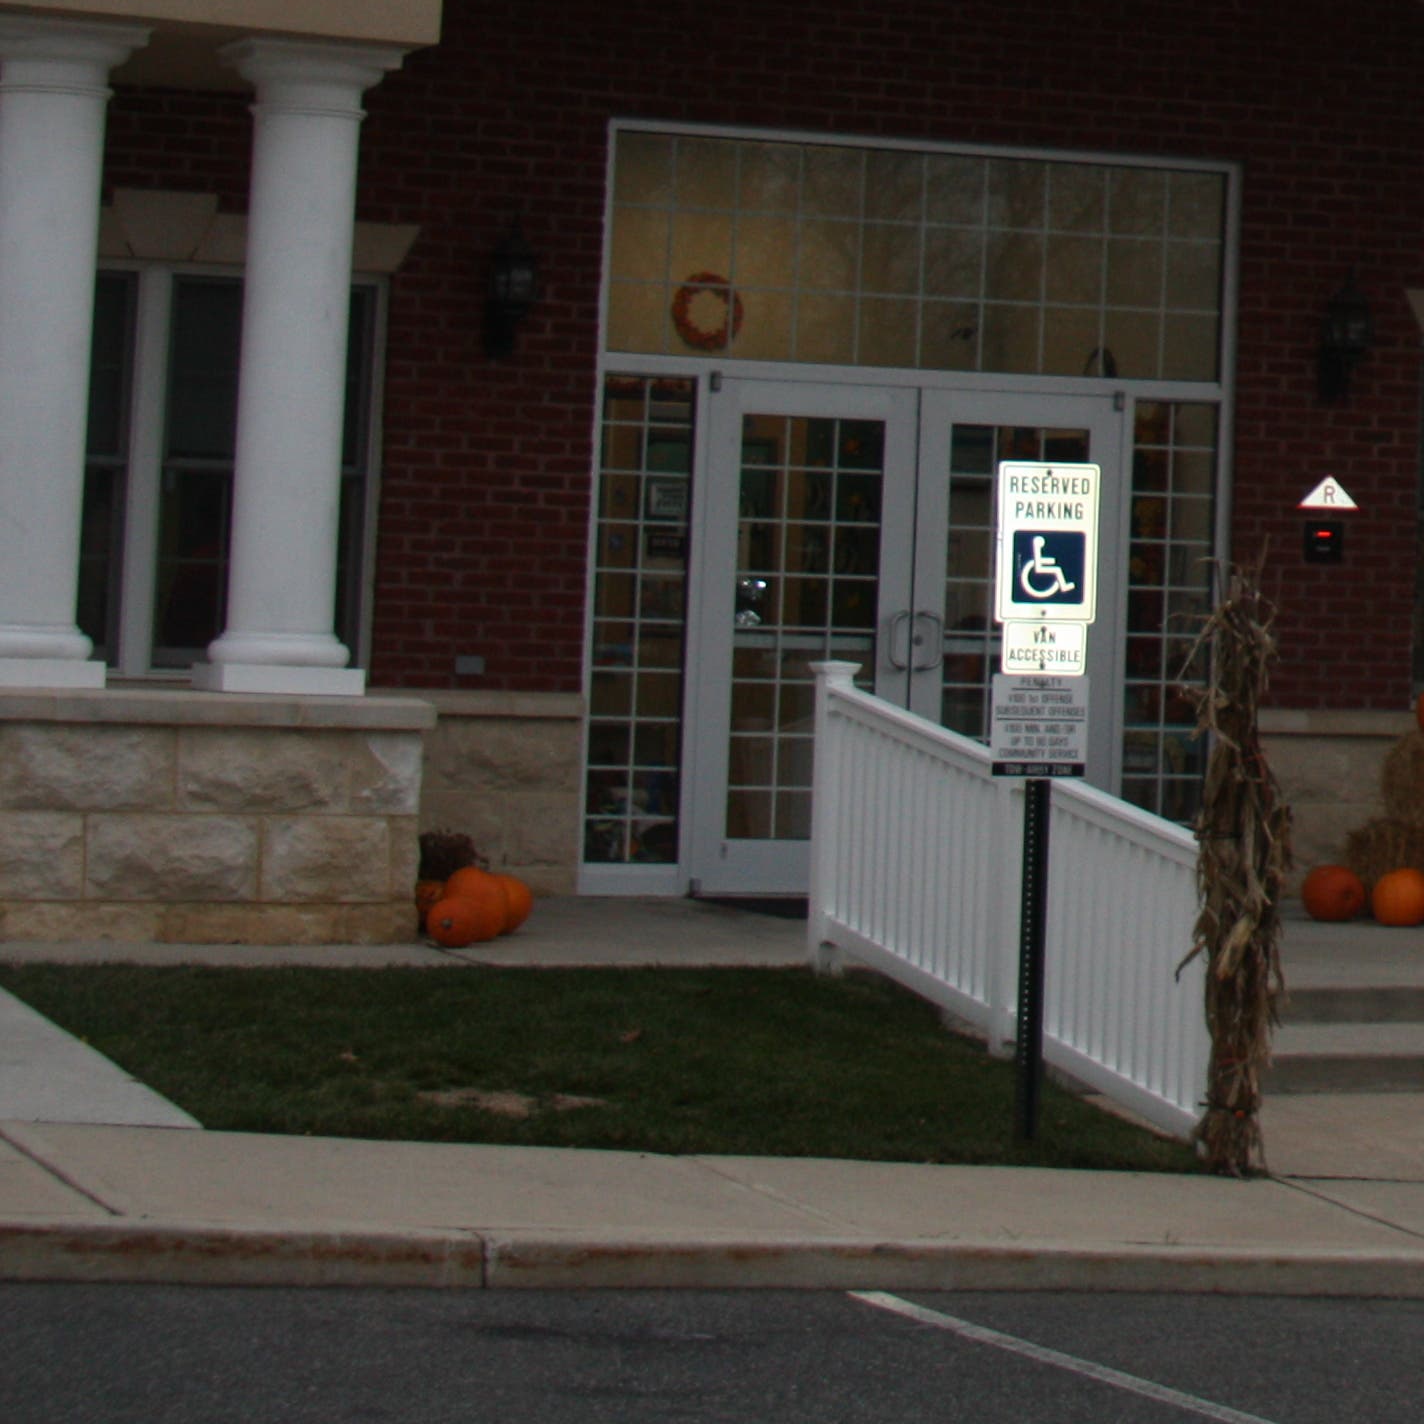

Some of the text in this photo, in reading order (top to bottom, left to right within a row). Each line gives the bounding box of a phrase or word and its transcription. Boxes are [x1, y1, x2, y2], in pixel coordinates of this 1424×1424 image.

[1009, 475, 1090, 495] RESERVED
[1324, 485, 1336, 504] R
[1015, 501, 1084, 520] PARKING
[1033, 630, 1056, 644] VAN
[1008, 647, 1081, 663] ACCESSIBLE
